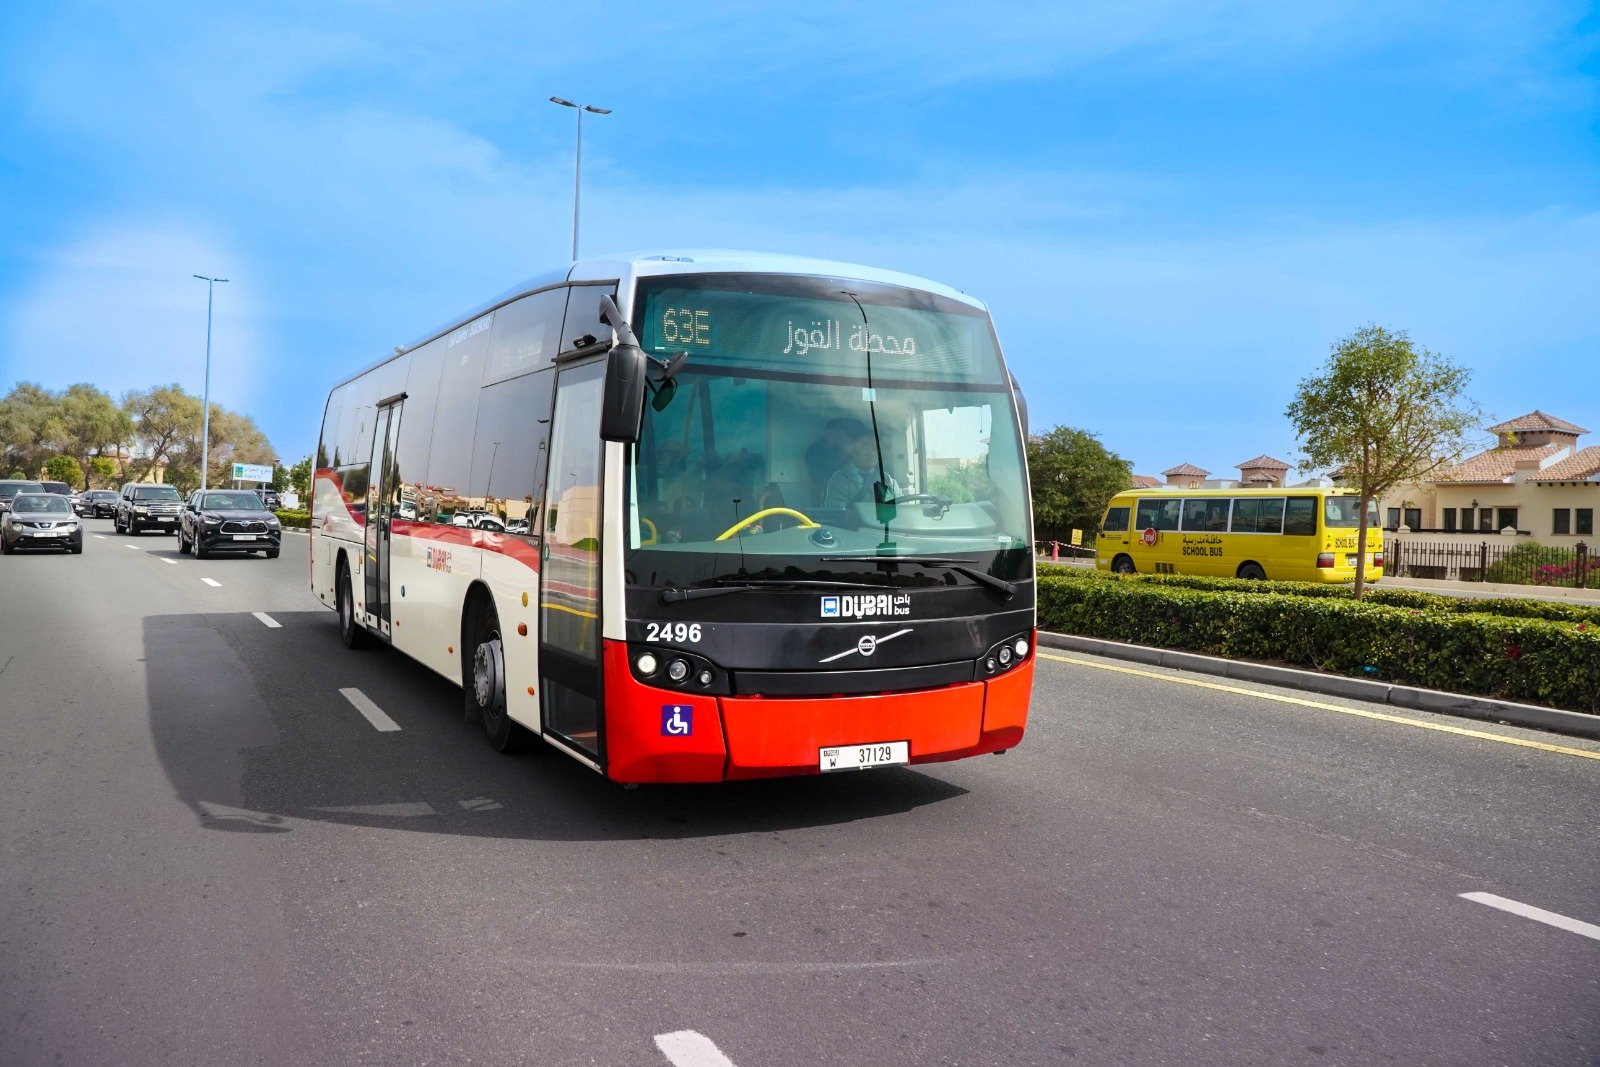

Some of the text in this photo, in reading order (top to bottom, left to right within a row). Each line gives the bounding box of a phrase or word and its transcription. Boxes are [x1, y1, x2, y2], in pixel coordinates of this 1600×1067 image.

[663, 308, 710, 344] 63E
[783, 316, 916, 355] محطة القوز
[1182, 546, 1223, 557] SCHOOL BUS
[842, 594, 893, 619] DUBAI
[894, 594, 911, 605] باص
[894, 607, 910, 615] bus
[646, 622, 702, 643] 2496
[829, 758, 837, 768] W
[859, 746, 891, 763] 37129
